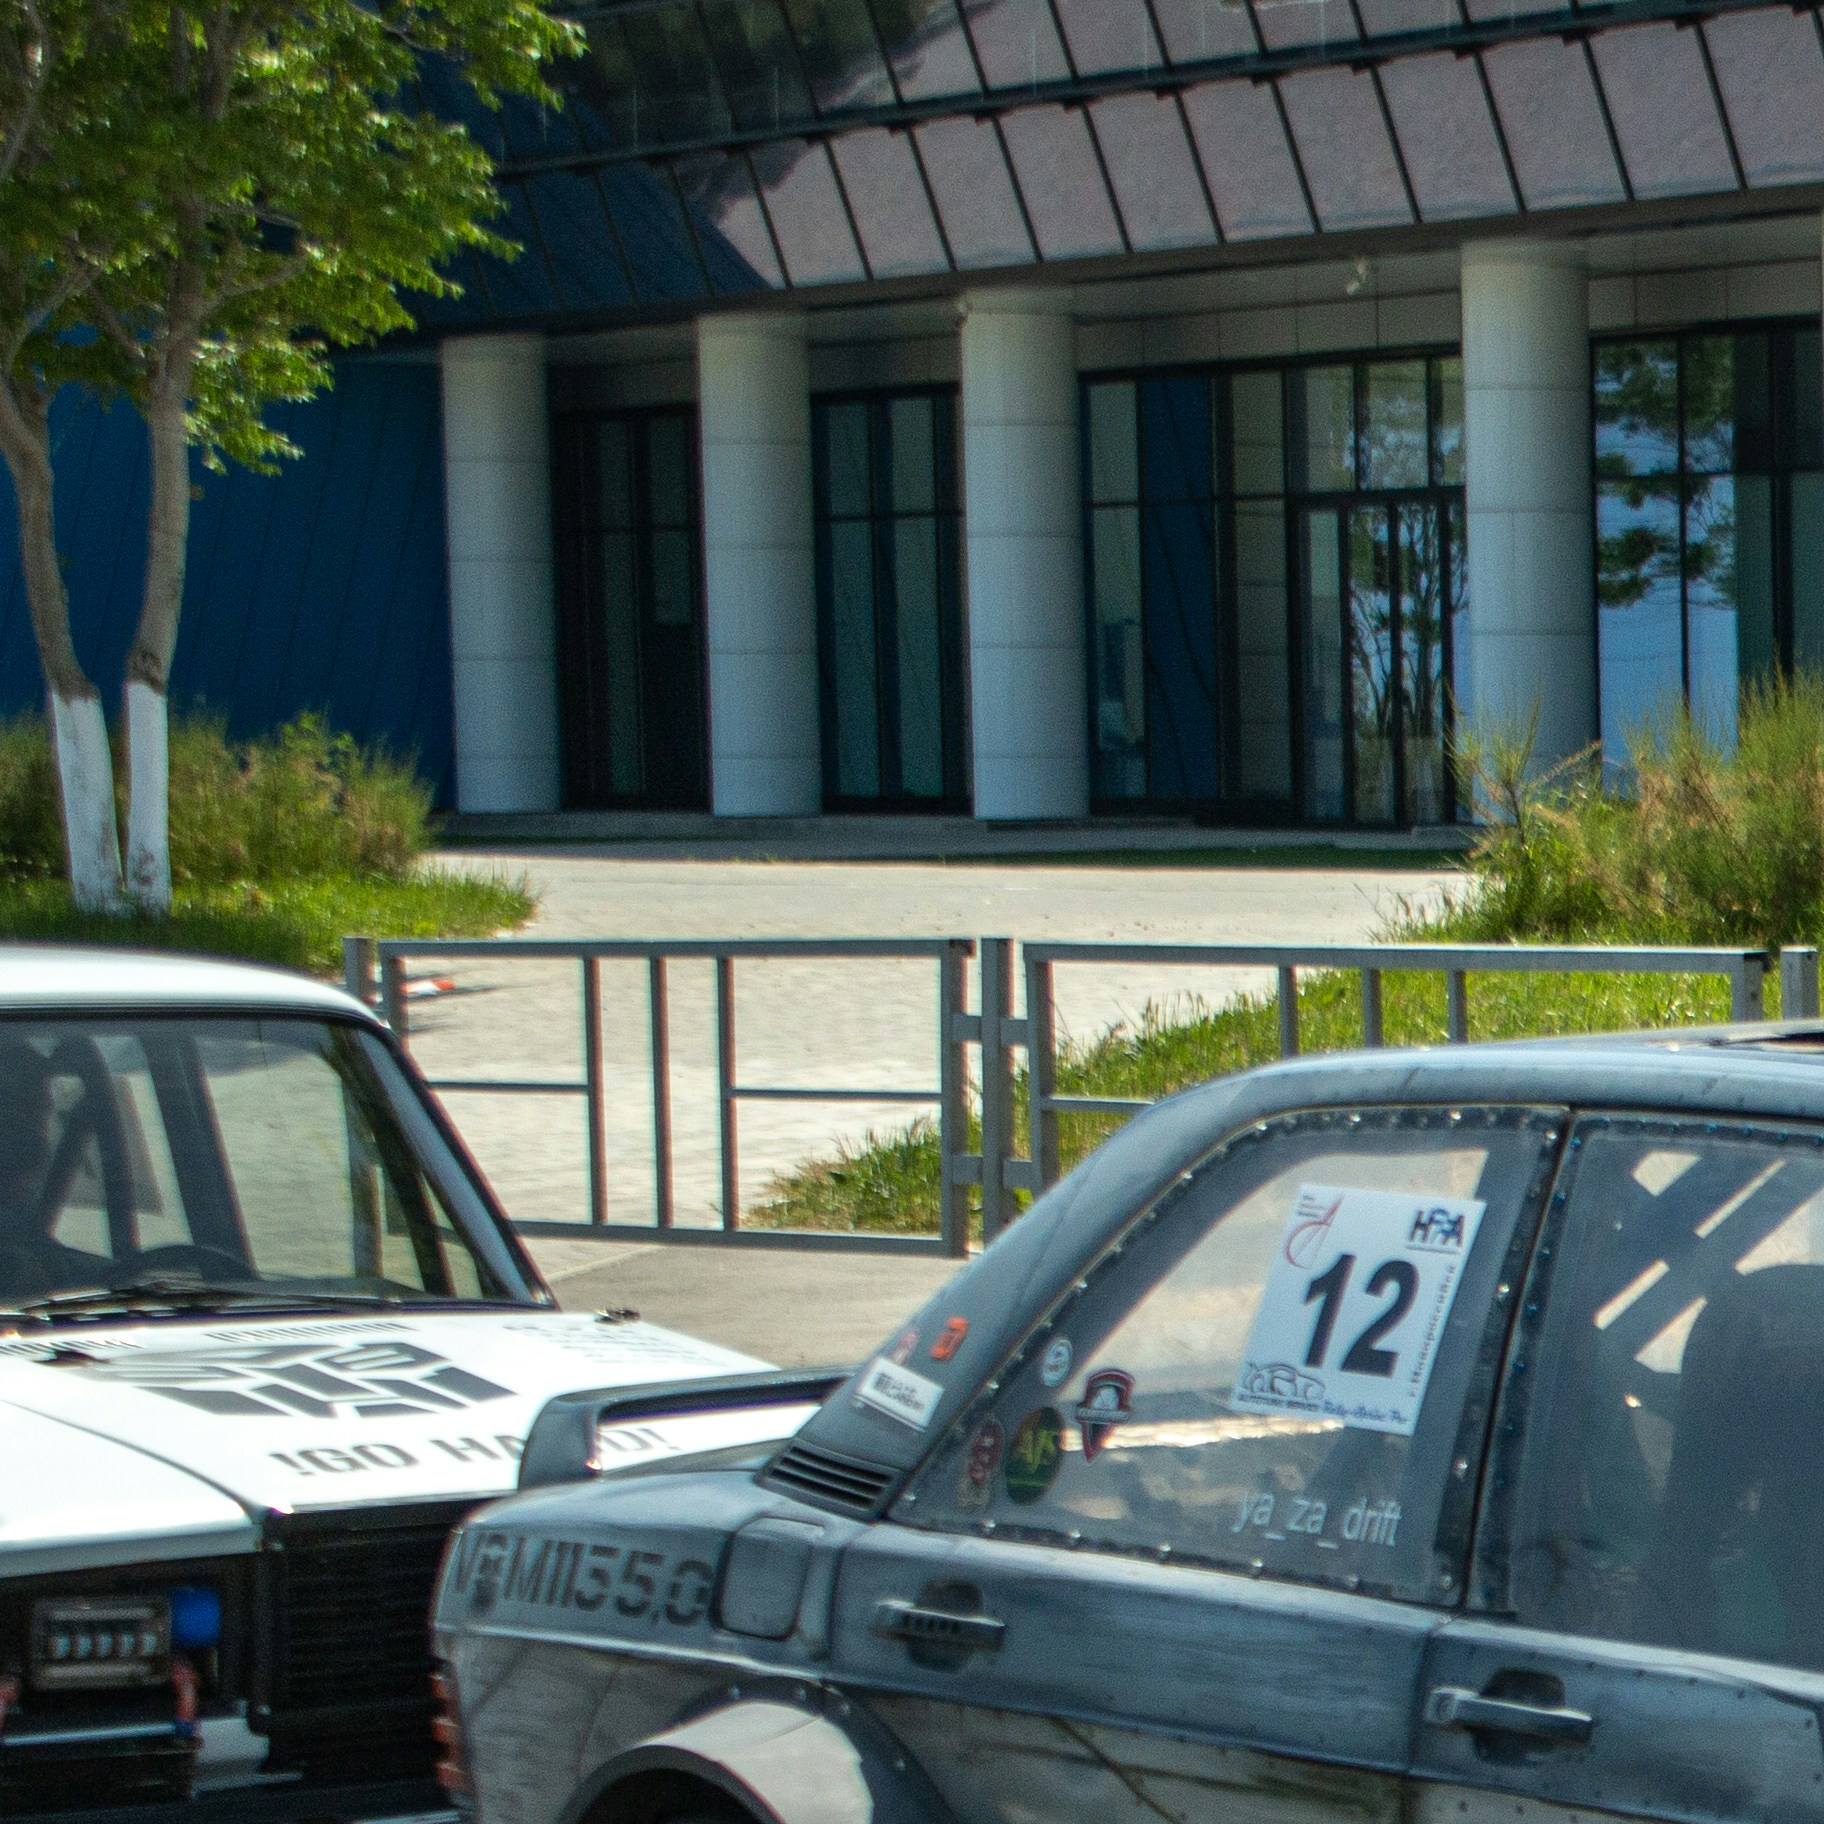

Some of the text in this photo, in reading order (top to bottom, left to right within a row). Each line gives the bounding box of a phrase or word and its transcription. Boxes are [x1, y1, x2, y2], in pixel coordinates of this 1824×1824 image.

[1303, 1252, 1420, 1379] 12
[269, 1426, 683, 1477] !GO HAD!
[1231, 1490, 1403, 1551] ya_za_drift
